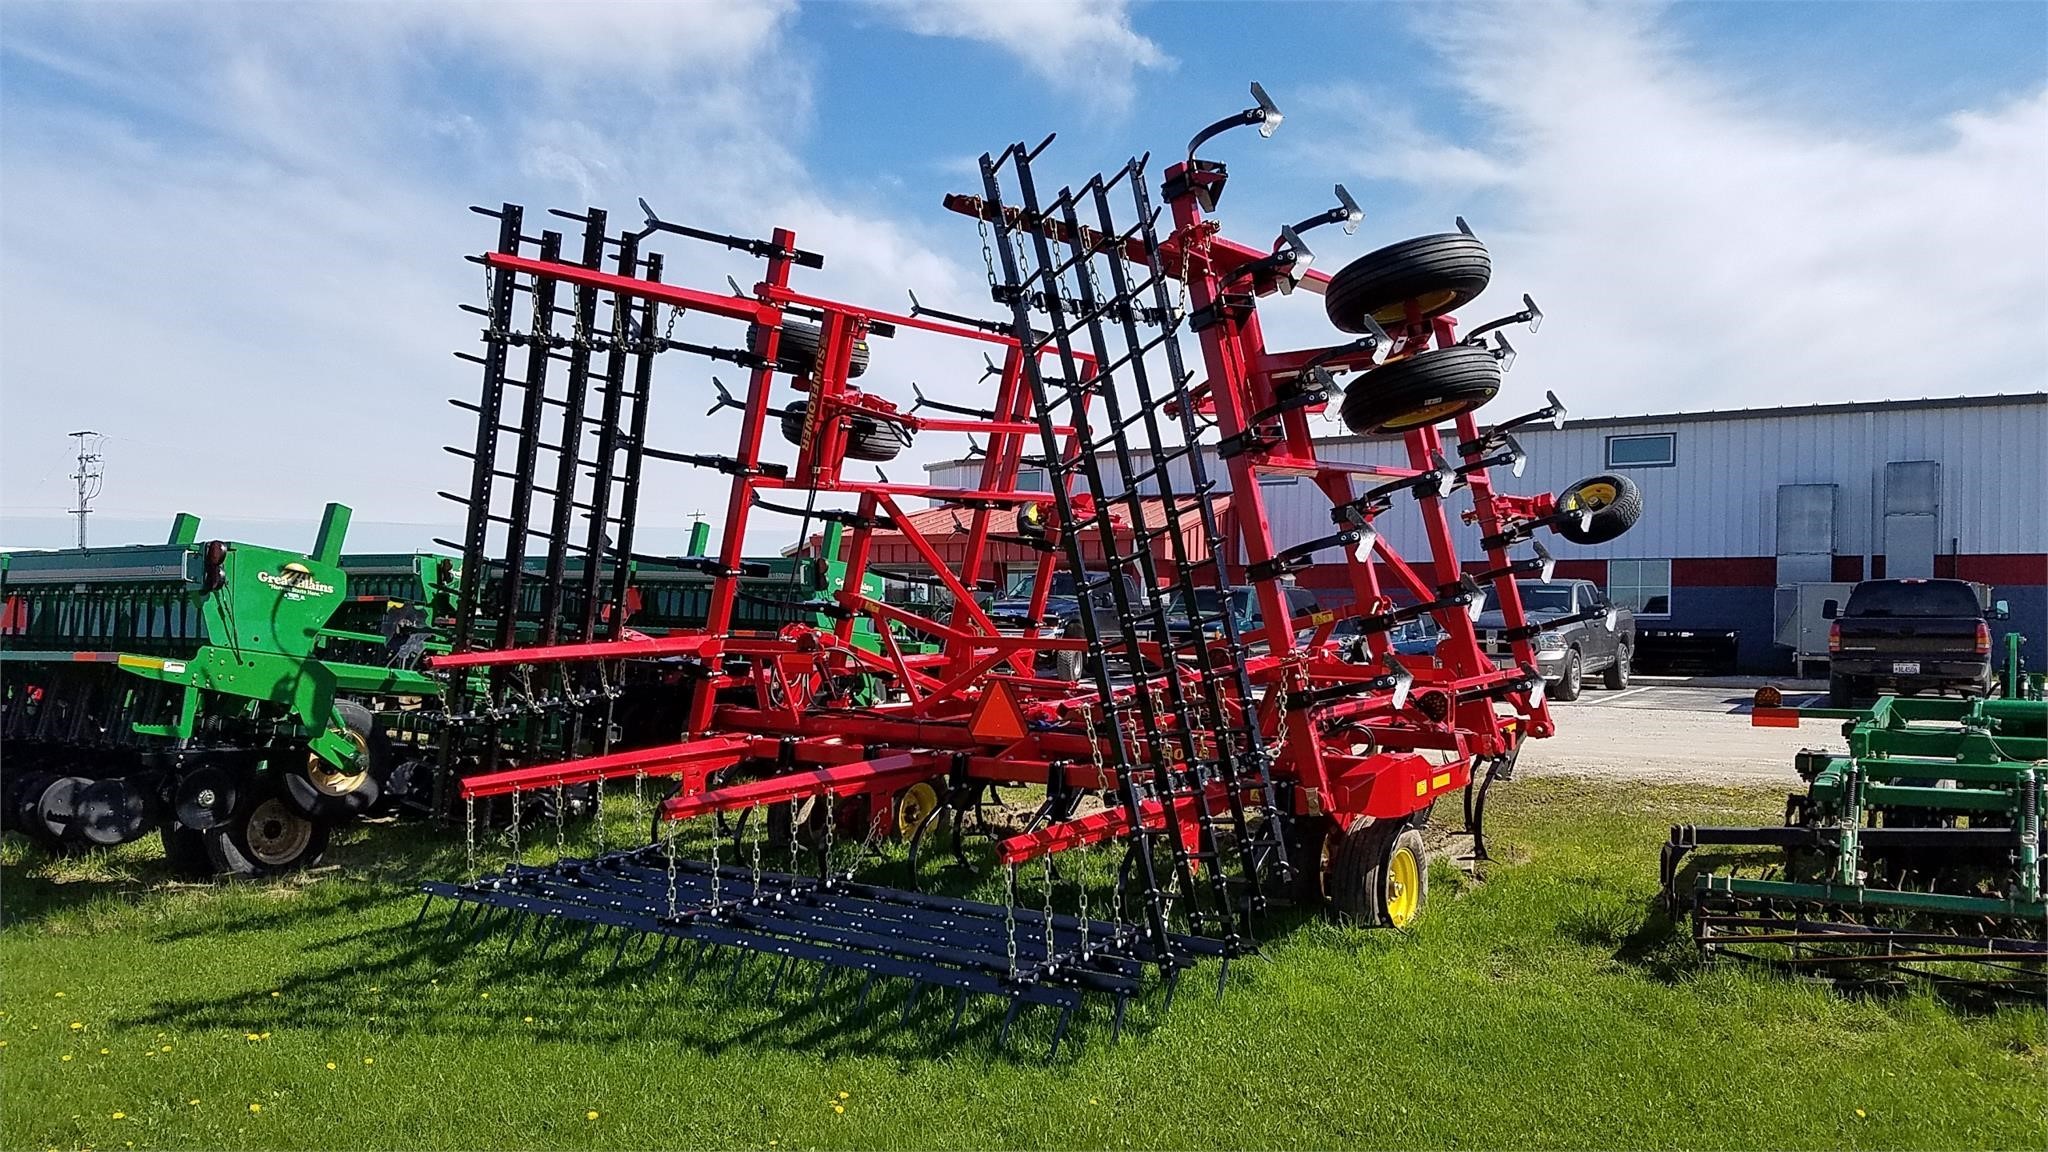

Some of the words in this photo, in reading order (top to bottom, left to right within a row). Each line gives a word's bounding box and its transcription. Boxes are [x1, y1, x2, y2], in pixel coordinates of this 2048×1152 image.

[802, 347, 826, 451] SUNFLOWER
[257, 571, 294, 587] Great
[296, 575, 334, 593] Plains
